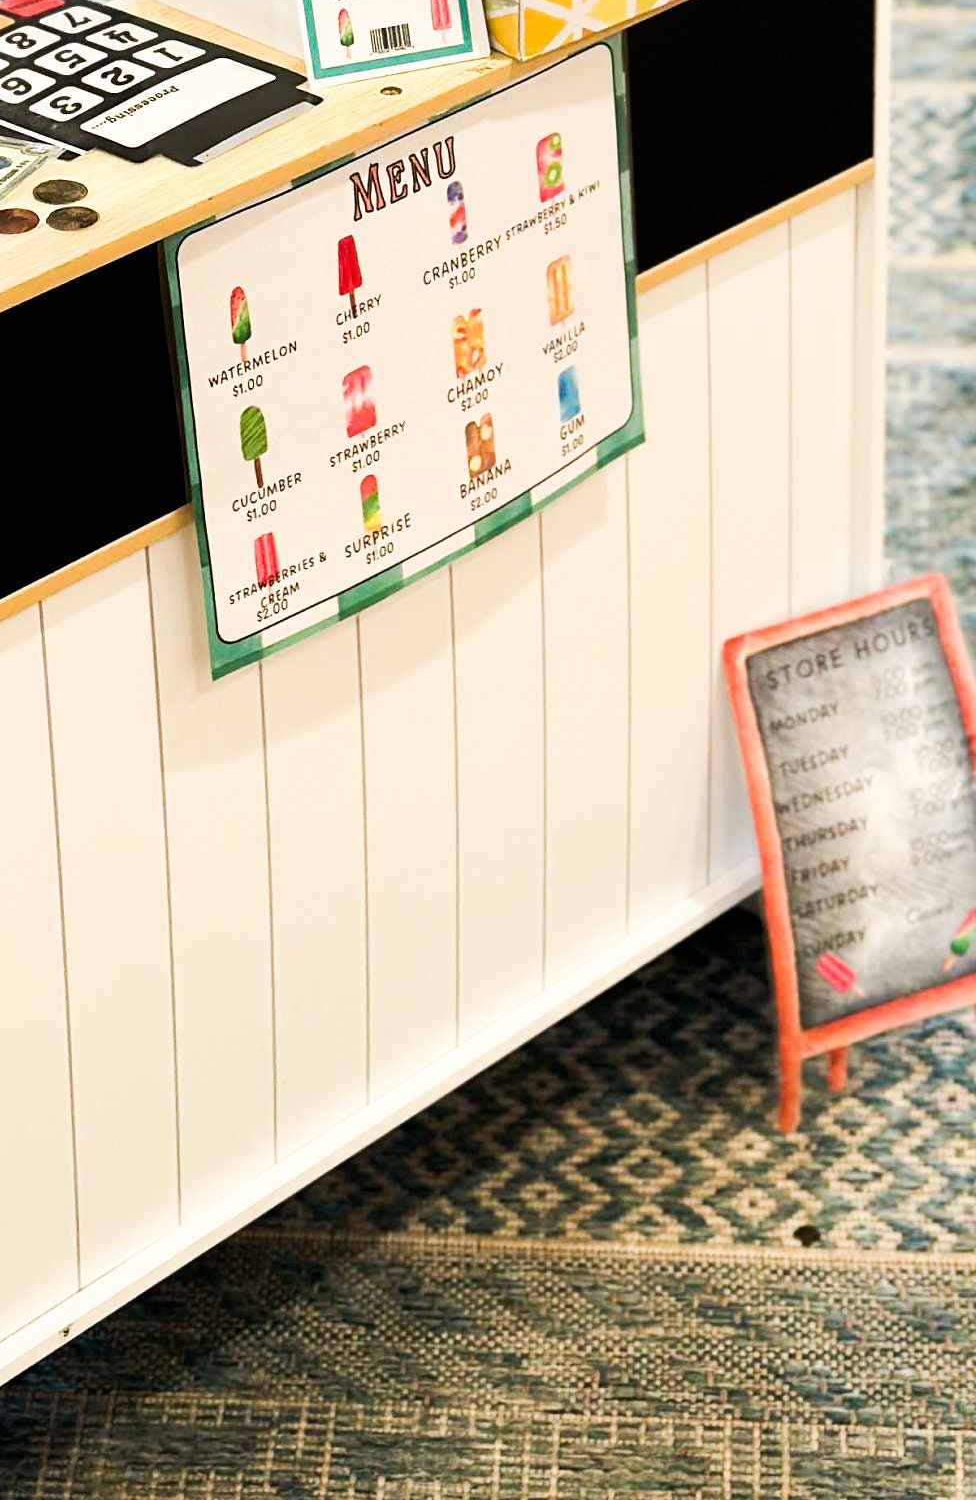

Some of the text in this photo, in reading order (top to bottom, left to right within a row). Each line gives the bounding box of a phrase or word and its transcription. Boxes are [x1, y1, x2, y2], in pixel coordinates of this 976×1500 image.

[63, 12, 92, 28] 7
[5, 32, 38, 50] 8
[0, 29, 139, 96] 4 5 6
[49, 47, 184, 115] 1 2 3
[505, 179, 601, 241] STRAWBERRY & KIWI
[543, 213, 567, 235] $1.50
[422, 234, 503, 286] CRANBERRY
[448, 267, 476, 290] $1.00
[336, 294, 382, 327] CHERRY
[342, 321, 371, 344] $1.00
[542, 321, 586, 356] VANILLA
[208, 340, 298, 388] WATERMELON
[553, 340, 578, 363] $2.00
[232, 374, 264, 398] $1.00
[447, 362, 504, 404] CHAMOY
[460, 388, 489, 412] $2.00
[559, 414, 586, 441] GUM
[329, 420, 407, 468] STRAWBERRY
[561, 434, 584, 457] $1.00
[352, 450, 381, 474] $1.00
[231, 471, 303, 512] CUCUMBER
[459, 458, 512, 499] BANANA
[246, 499, 277, 522] $1.00
[470, 487, 498, 512] $2.00
[344, 512, 413, 559] SURPRISE
[366, 541, 395, 565] $1.00
[229, 551, 327, 606] STRAWBERRIES &
[256, 598, 289, 623] $2.00
[260, 582, 301, 609] CREAM
[766, 647, 844, 691] STORE
[854, 617, 936, 660] HOURS
[769, 703, 839, 735] MONDAY
[779, 743, 850, 778] TUESDAY
[776, 774, 874, 815] WEDNESDAY
[785, 816, 870, 851] THURSDAY
[790, 856, 850, 884] FRIDAY
